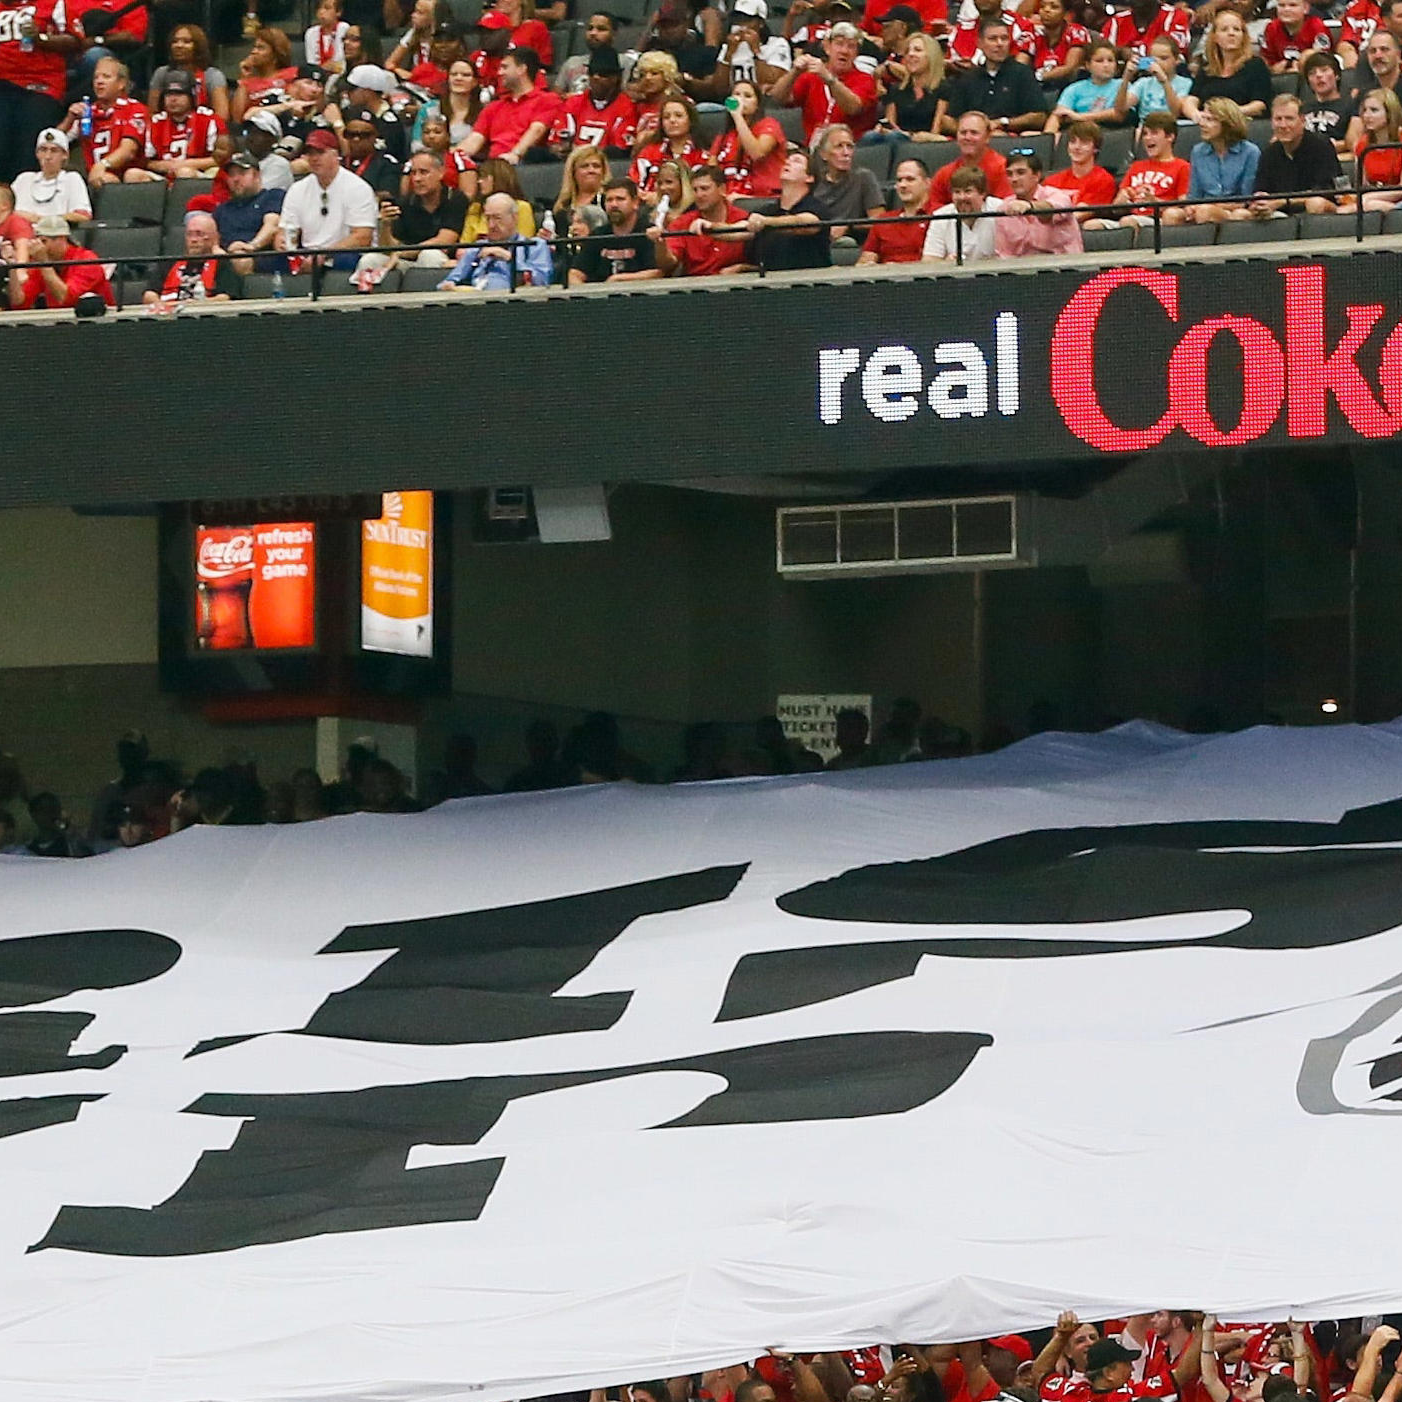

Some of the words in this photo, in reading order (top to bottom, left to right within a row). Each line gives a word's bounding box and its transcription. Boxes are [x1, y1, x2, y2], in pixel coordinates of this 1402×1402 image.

[818, 311, 1020, 425] real
[256, 527, 313, 546] refresh
[266, 544, 306, 564] your
[262, 562, 310, 581] game
